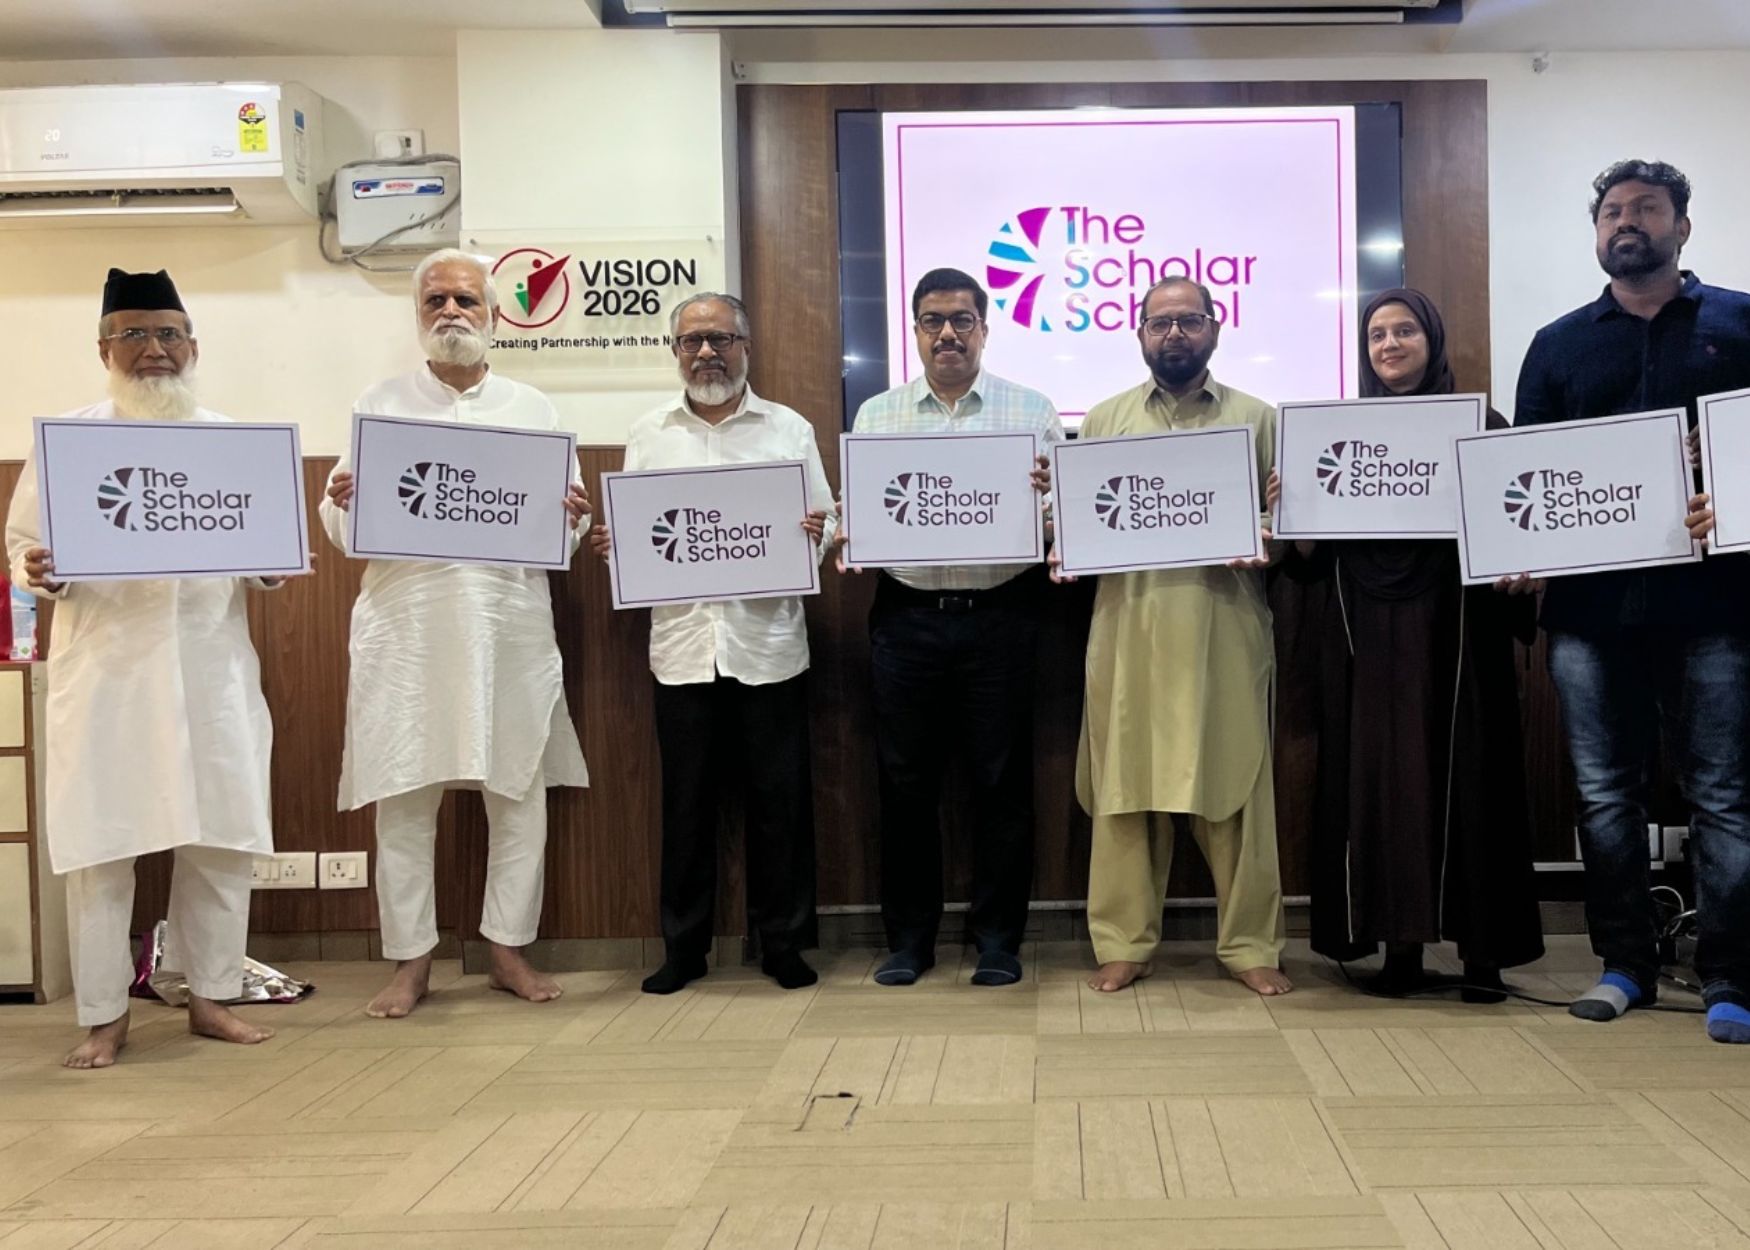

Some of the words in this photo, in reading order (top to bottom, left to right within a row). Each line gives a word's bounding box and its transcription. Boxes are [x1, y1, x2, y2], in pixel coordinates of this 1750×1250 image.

[1060, 206, 1145, 244] The
[579, 258, 697, 288] VISION
[1064, 248, 1257, 289] Scholar
[583, 289, 661, 317] 2026
[1065, 291, 1240, 333] Schl
[541, 335, 610, 350] Partnership
[612, 336, 638, 346] with
[640, 335, 660, 346] the
[1350, 440, 1388, 459] The
[138, 467, 189, 488] The
[435, 462, 476, 483] The
[1350, 458, 1439, 478] Scholar
[1538, 469, 1583, 488] The
[915, 472, 953, 489] The
[1126, 475, 1165, 492] The
[1349, 478, 1430, 497] School
[142, 489, 252, 510] Scholar
[435, 482, 528, 507] Scholar
[917, 489, 1001, 508] Scholar
[1129, 489, 1215, 511] Scholar
[1543, 483, 1642, 509] Scholar
[144, 511, 245, 532] School
[434, 502, 519, 526] School
[682, 508, 721, 525] The
[918, 507, 994, 526] School
[1130, 507, 1209, 530] School
[1545, 502, 1636, 530] School
[686, 522, 772, 544] Scholar
[688, 540, 766, 563] School
